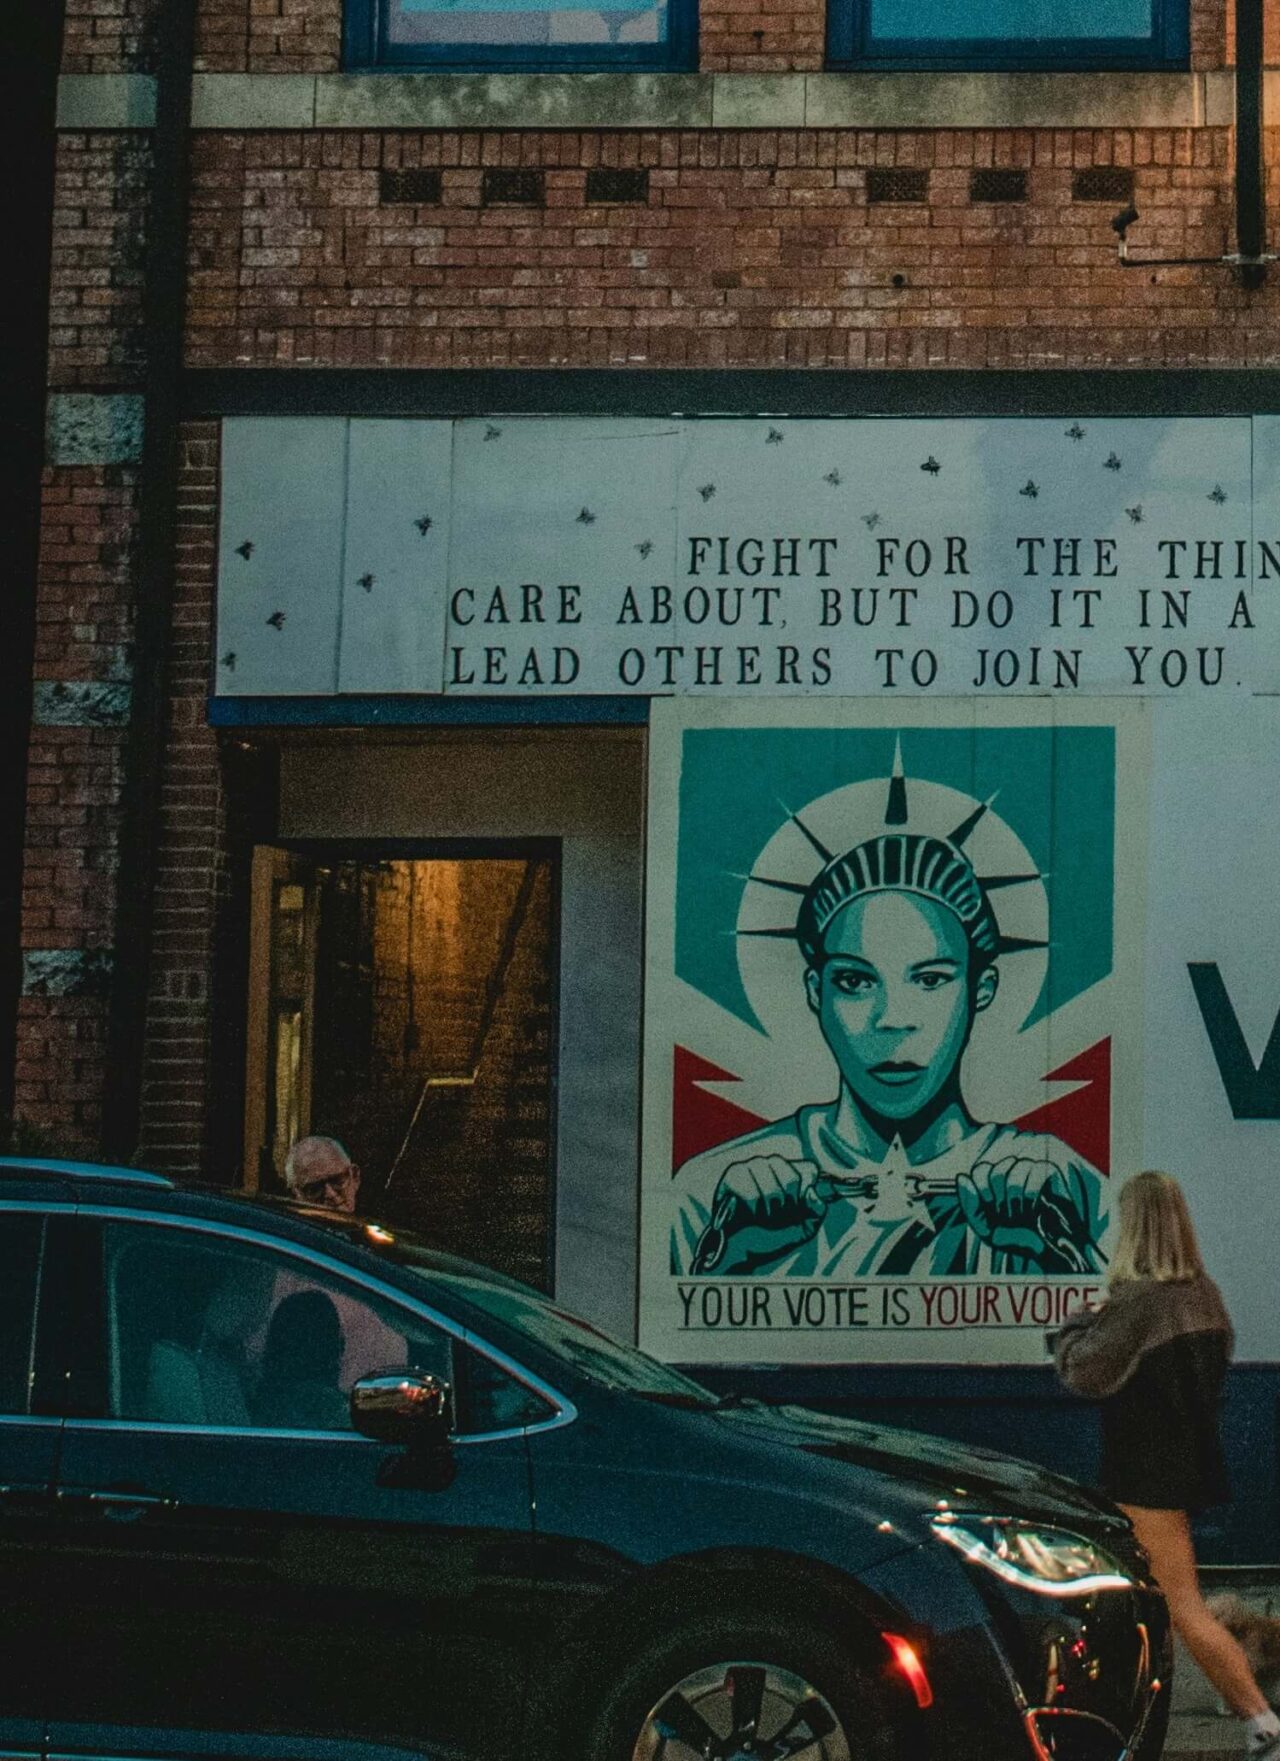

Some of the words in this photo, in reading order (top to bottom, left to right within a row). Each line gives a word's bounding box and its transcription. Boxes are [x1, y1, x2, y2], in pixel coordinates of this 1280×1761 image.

[687, 536, 838, 577] FIGHT
[876, 536, 970, 577] FOR
[1016, 537, 1118, 577] THE
[450, 584, 582, 626] CARE
[616, 585, 788, 629] ABOUT,
[819, 588, 918, 627] BUT
[951, 590, 1015, 629] DO
[1050, 589, 1102, 628] IT
[1139, 589, 1191, 629] IN
[1228, 589, 1256, 629] A
[450, 646, 581, 686] LEAD
[618, 645, 832, 687] OTHERS
[875, 649, 939, 688] TO
[972, 647, 1082, 689] JOIN
[1125, 646, 1242, 688] YOU.
[677, 1286, 773, 1327] YOUR
[783, 1286, 869, 1327] VOTE
[881, 1287, 911, 1327] IS
[919, 1285, 1002, 1326] YOUR
